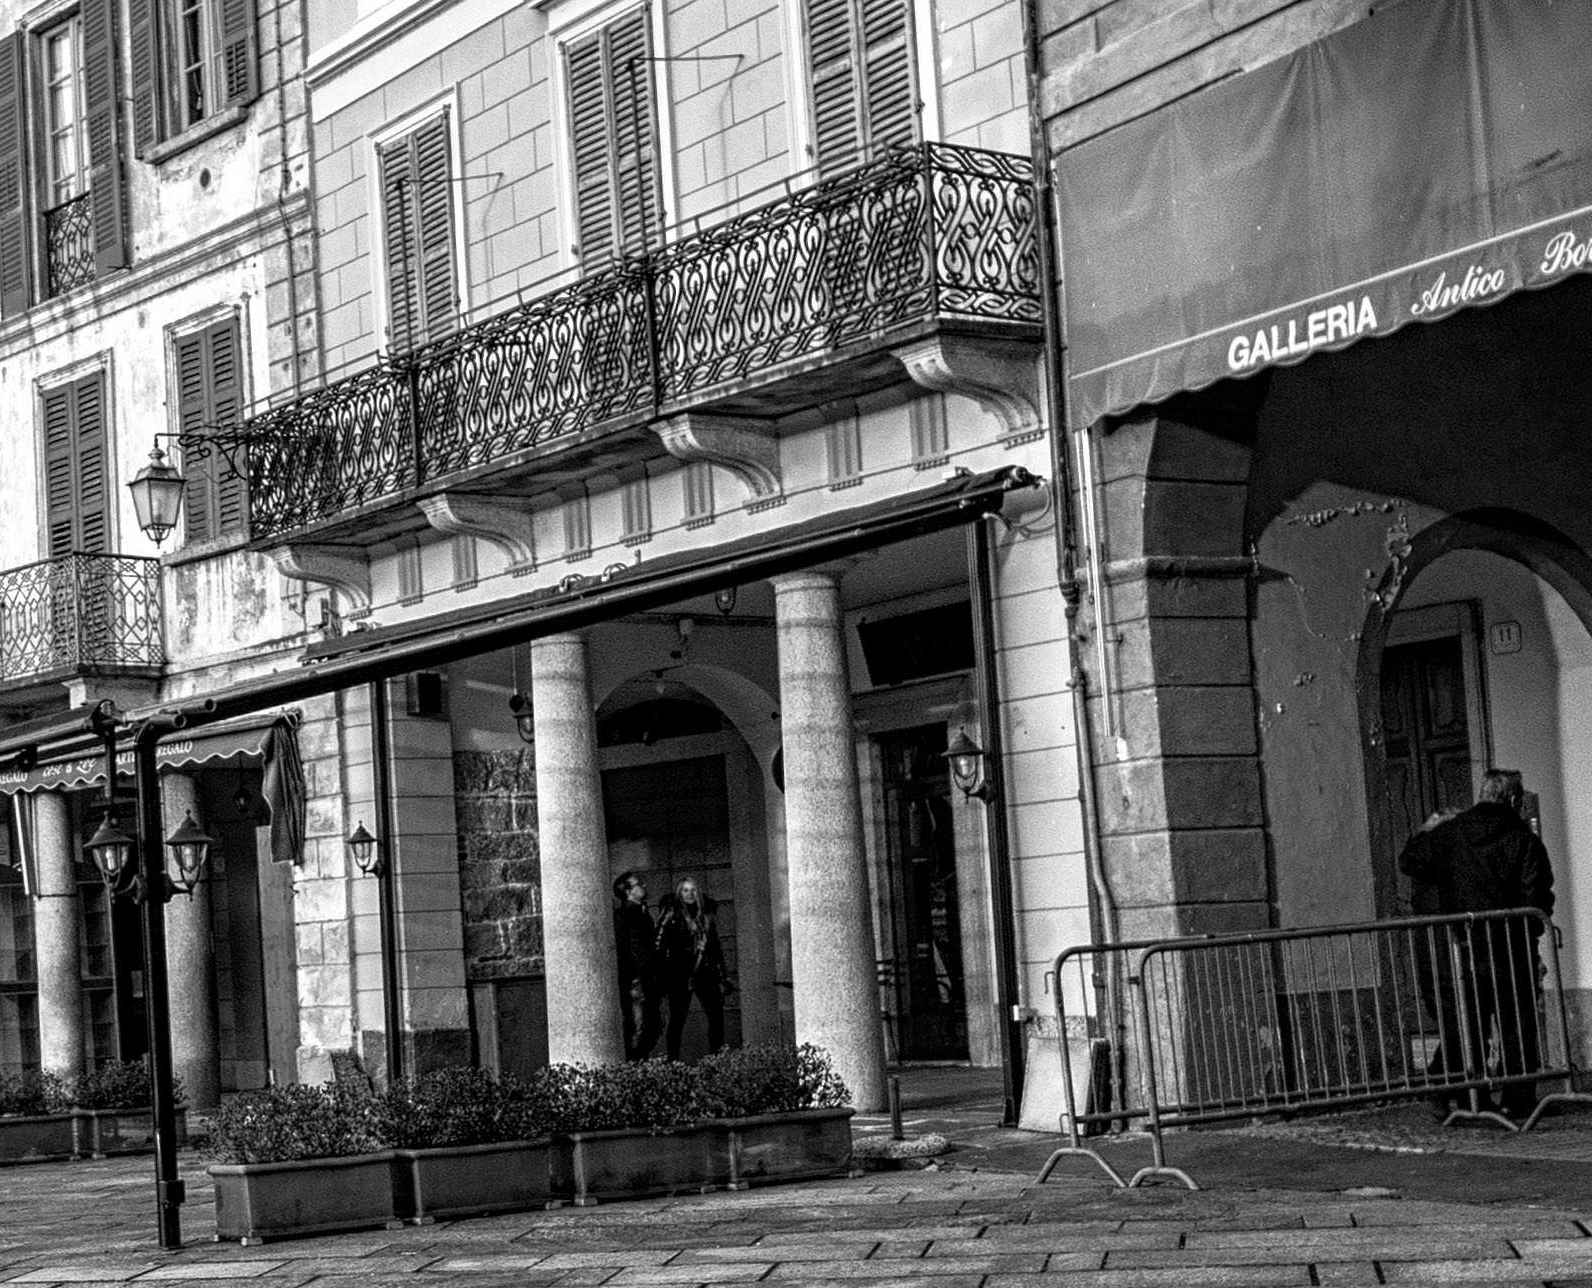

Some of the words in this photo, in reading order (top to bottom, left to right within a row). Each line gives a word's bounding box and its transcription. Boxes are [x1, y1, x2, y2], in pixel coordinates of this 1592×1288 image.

[1228, 296, 1378, 370] GALLERIA
[1411, 265, 1506, 314] Antico
[156, 740, 194, 757] REGALO
